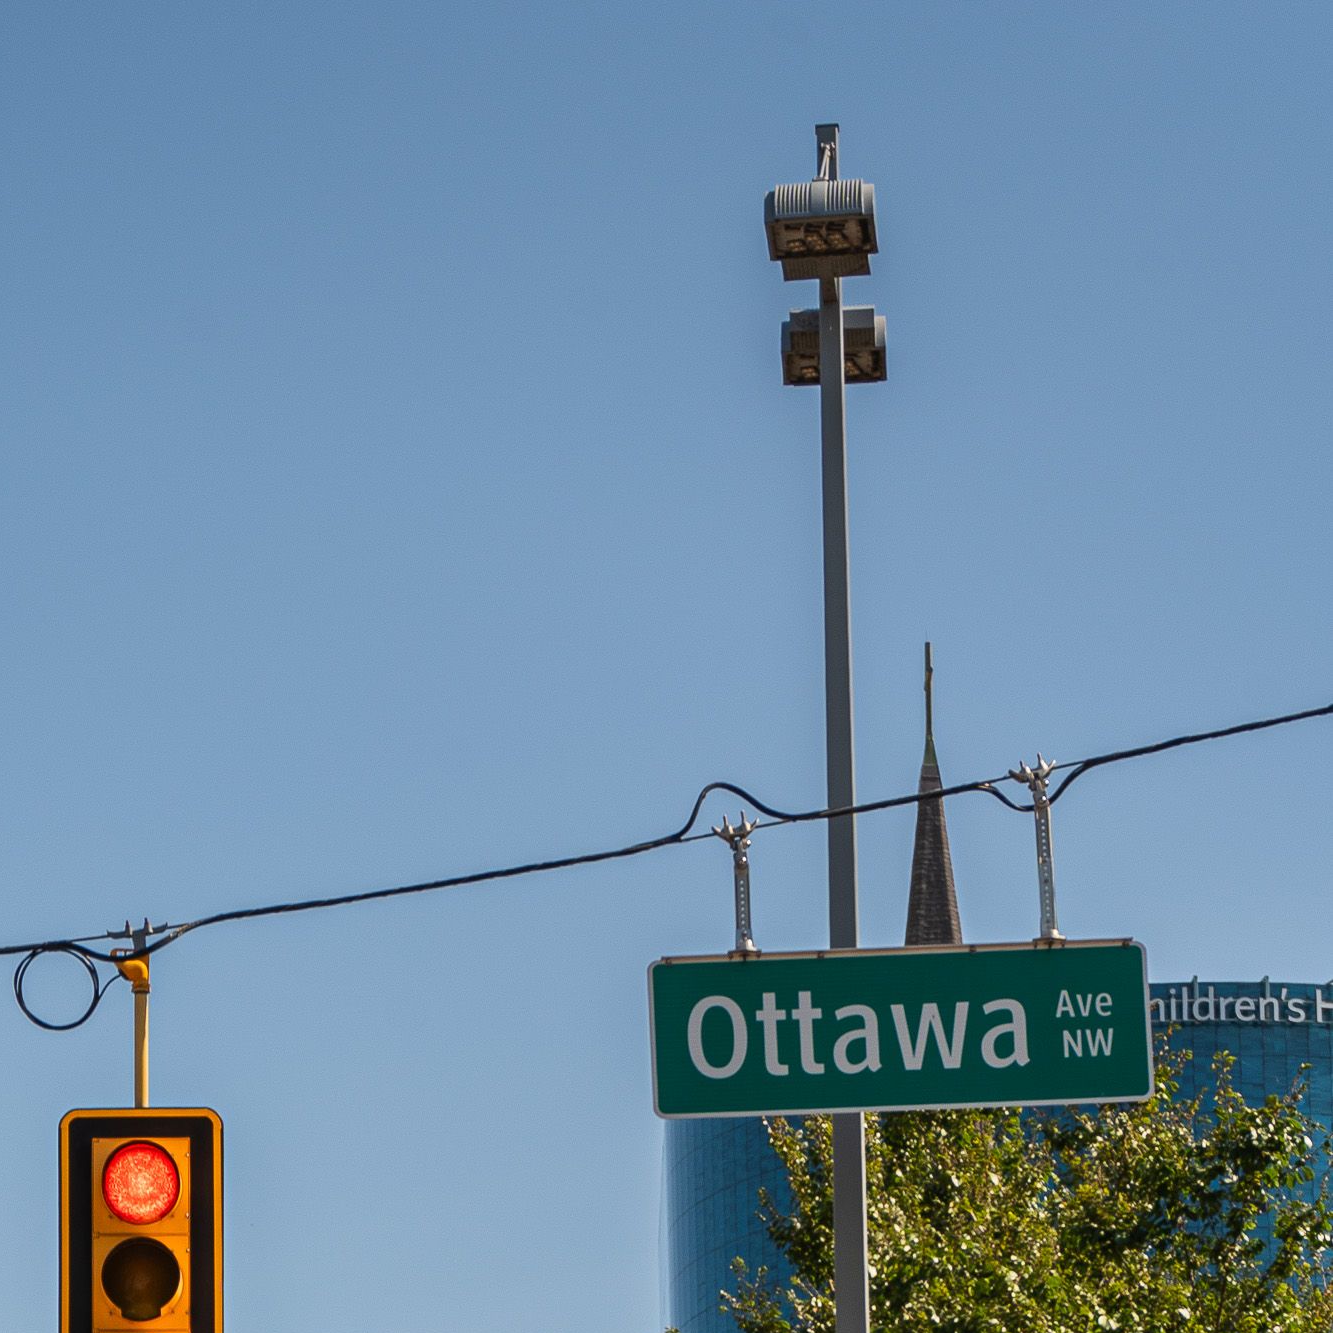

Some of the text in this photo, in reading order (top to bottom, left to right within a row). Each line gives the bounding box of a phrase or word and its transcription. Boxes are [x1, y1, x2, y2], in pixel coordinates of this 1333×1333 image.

[1056, 989, 1113, 1018] Ave
[687, 990, 1030, 1080] Ottawa
[1062, 1027, 1114, 1058] NW
